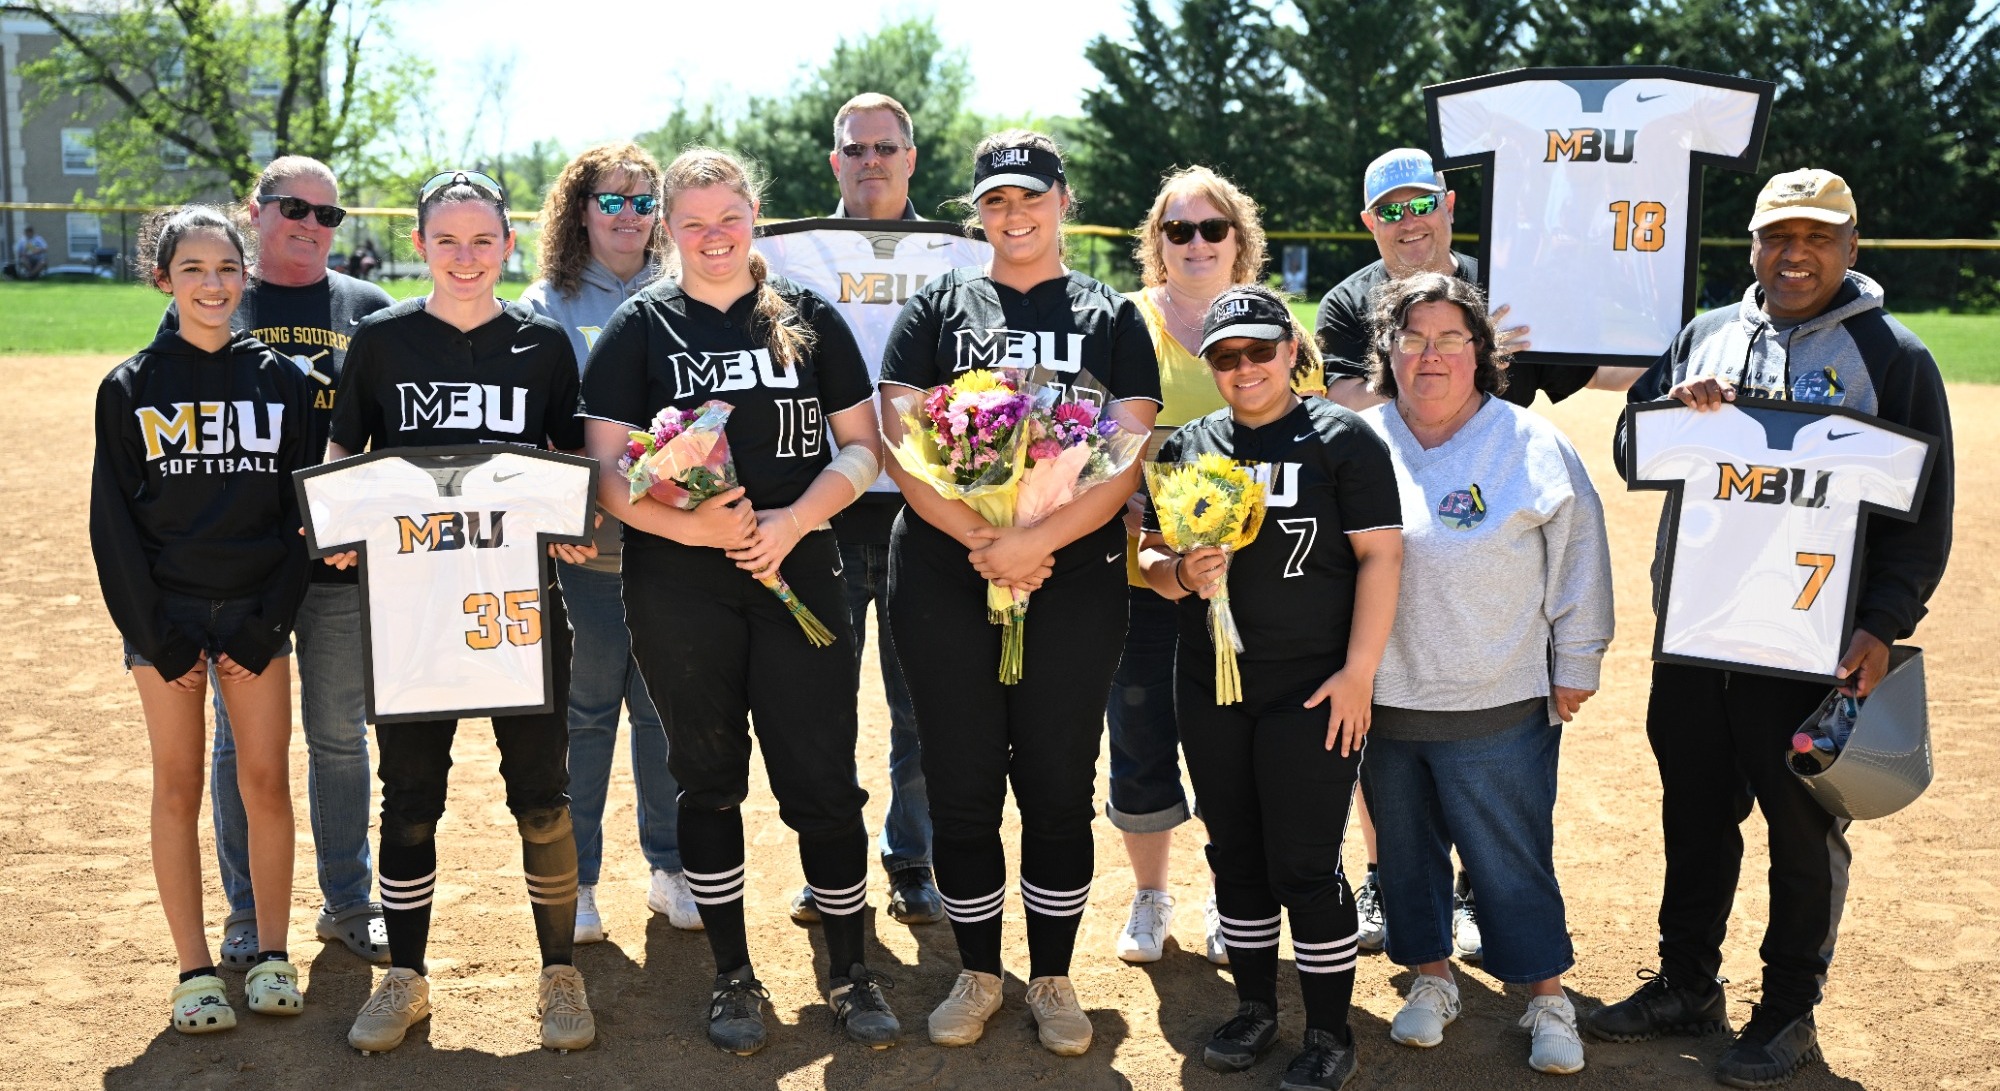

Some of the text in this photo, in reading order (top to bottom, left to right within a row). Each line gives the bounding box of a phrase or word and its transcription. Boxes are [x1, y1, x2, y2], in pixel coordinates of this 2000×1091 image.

[992, 148, 1030, 166] MBU
[1543, 127, 1638, 164] MBU
[1609, 200, 1667, 252] 18
[250, 326, 352, 351] TING SQUIRR
[952, 328, 1087, 374] MBU
[667, 348, 800, 399] MBU
[134, 401, 286, 462] MBU
[395, 381, 529, 435] MBU
[774, 398, 823, 458] 19
[159, 457, 278, 478] SOFTBALL
[1713, 462, 1834, 509] MBU
[393, 510, 507, 554] MBU
[1277, 517, 1318, 579] 7
[1792, 551, 1836, 612] 7
[462, 588, 543, 650] 35
